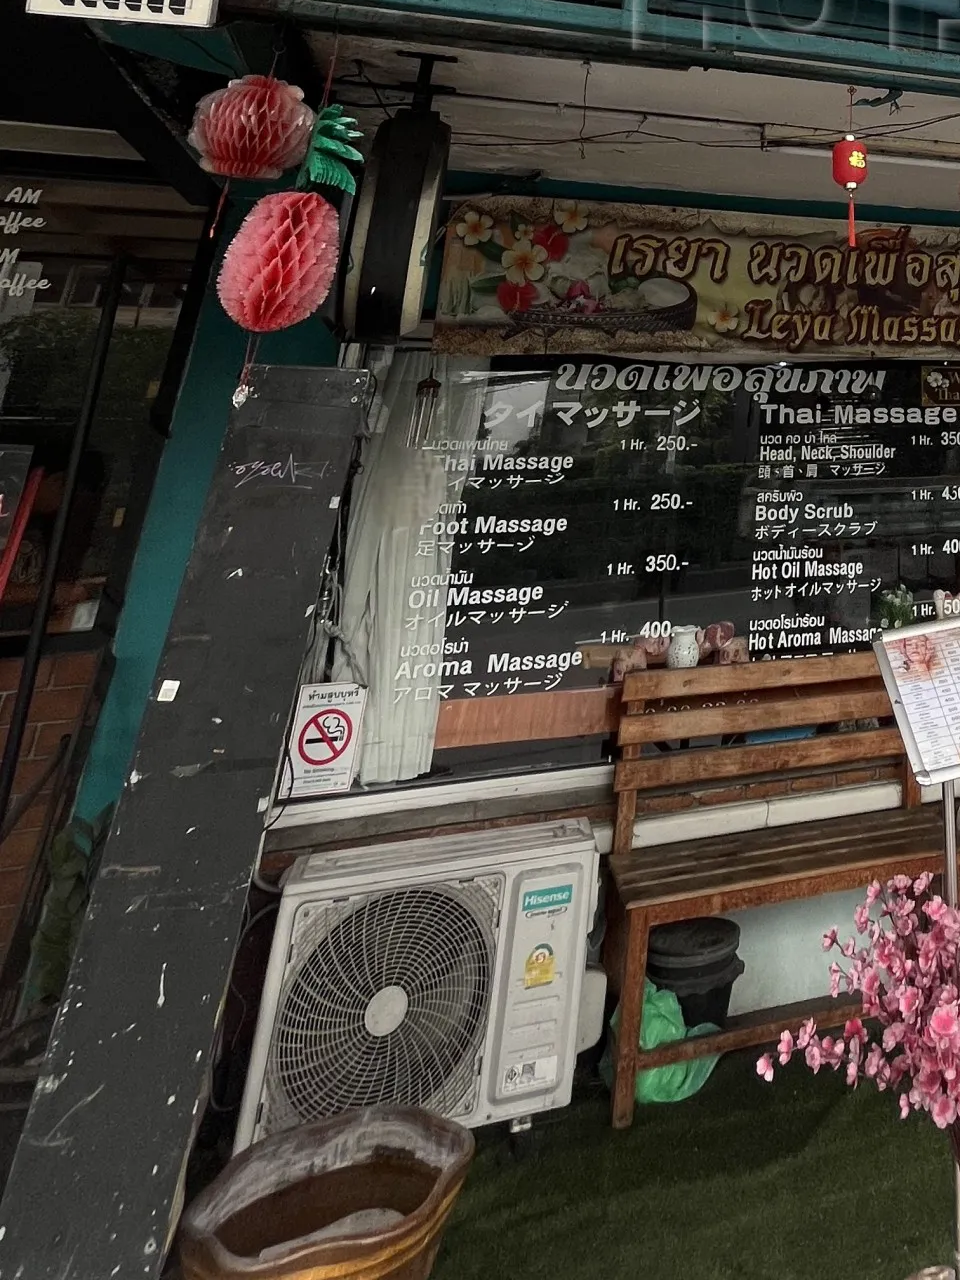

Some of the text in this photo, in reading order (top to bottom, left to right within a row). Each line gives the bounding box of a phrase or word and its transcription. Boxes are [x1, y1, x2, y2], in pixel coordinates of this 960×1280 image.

[4, 186, 43, 205] AM
[0, 211, 47, 234] offee
[0, 248, 21, 264] M
[609, 234, 731, 284] เรยา
[0, 273, 52, 297] offee
[742, 299, 836, 354] Leya
[760, 403, 958, 426] Thai Massage
[620, 439, 626, 451] 1
[630, 438, 647, 451] Hr.
[911, 435, 917, 446] 1
[919, 435, 934, 446] Hr.
[759, 443, 897, 463] Head, Neck, Shoulder
[483, 454, 574, 473] Massage
[448, 473, 565, 491] イマッサージ
[613, 499, 619, 511] 1
[623, 497, 641, 511] Hr.
[911, 490, 917, 501] 1
[919, 489, 935, 501] Hr.
[755, 502, 854, 524] Body Scrub
[419, 516, 568, 536] Foot Massage
[754, 520, 878, 540] ボディースクラブ
[415, 535, 536, 557] 足マッサージ
[753, 543, 824, 562] นวดน้ำมันร้อน
[911, 545, 917, 556] 1
[920, 544, 935, 556] Hr.
[411, 568, 474, 588] นวดน้ำมัน
[606, 563, 613, 575] 1
[618, 561, 635, 576] Hr.
[751, 560, 864, 580] Hot Oil Massage
[408, 585, 544, 609] Oil Massage
[404, 600, 570, 631] オイルマッサージ
[912, 605, 918, 617] 1
[921, 604, 936, 617] Hr.
[749, 613, 825, 632] นวดอโรม่าร้อน
[600, 631, 606, 643] 1
[611, 629, 629, 643] Hr.
[749, 632, 775, 651] Hot
[777, 630, 822, 649] Aroma
[400, 637, 469, 658] นวดอโรม่า
[394, 650, 583, 681] Aroma Massage
[524, 891, 570, 907] Hisense
